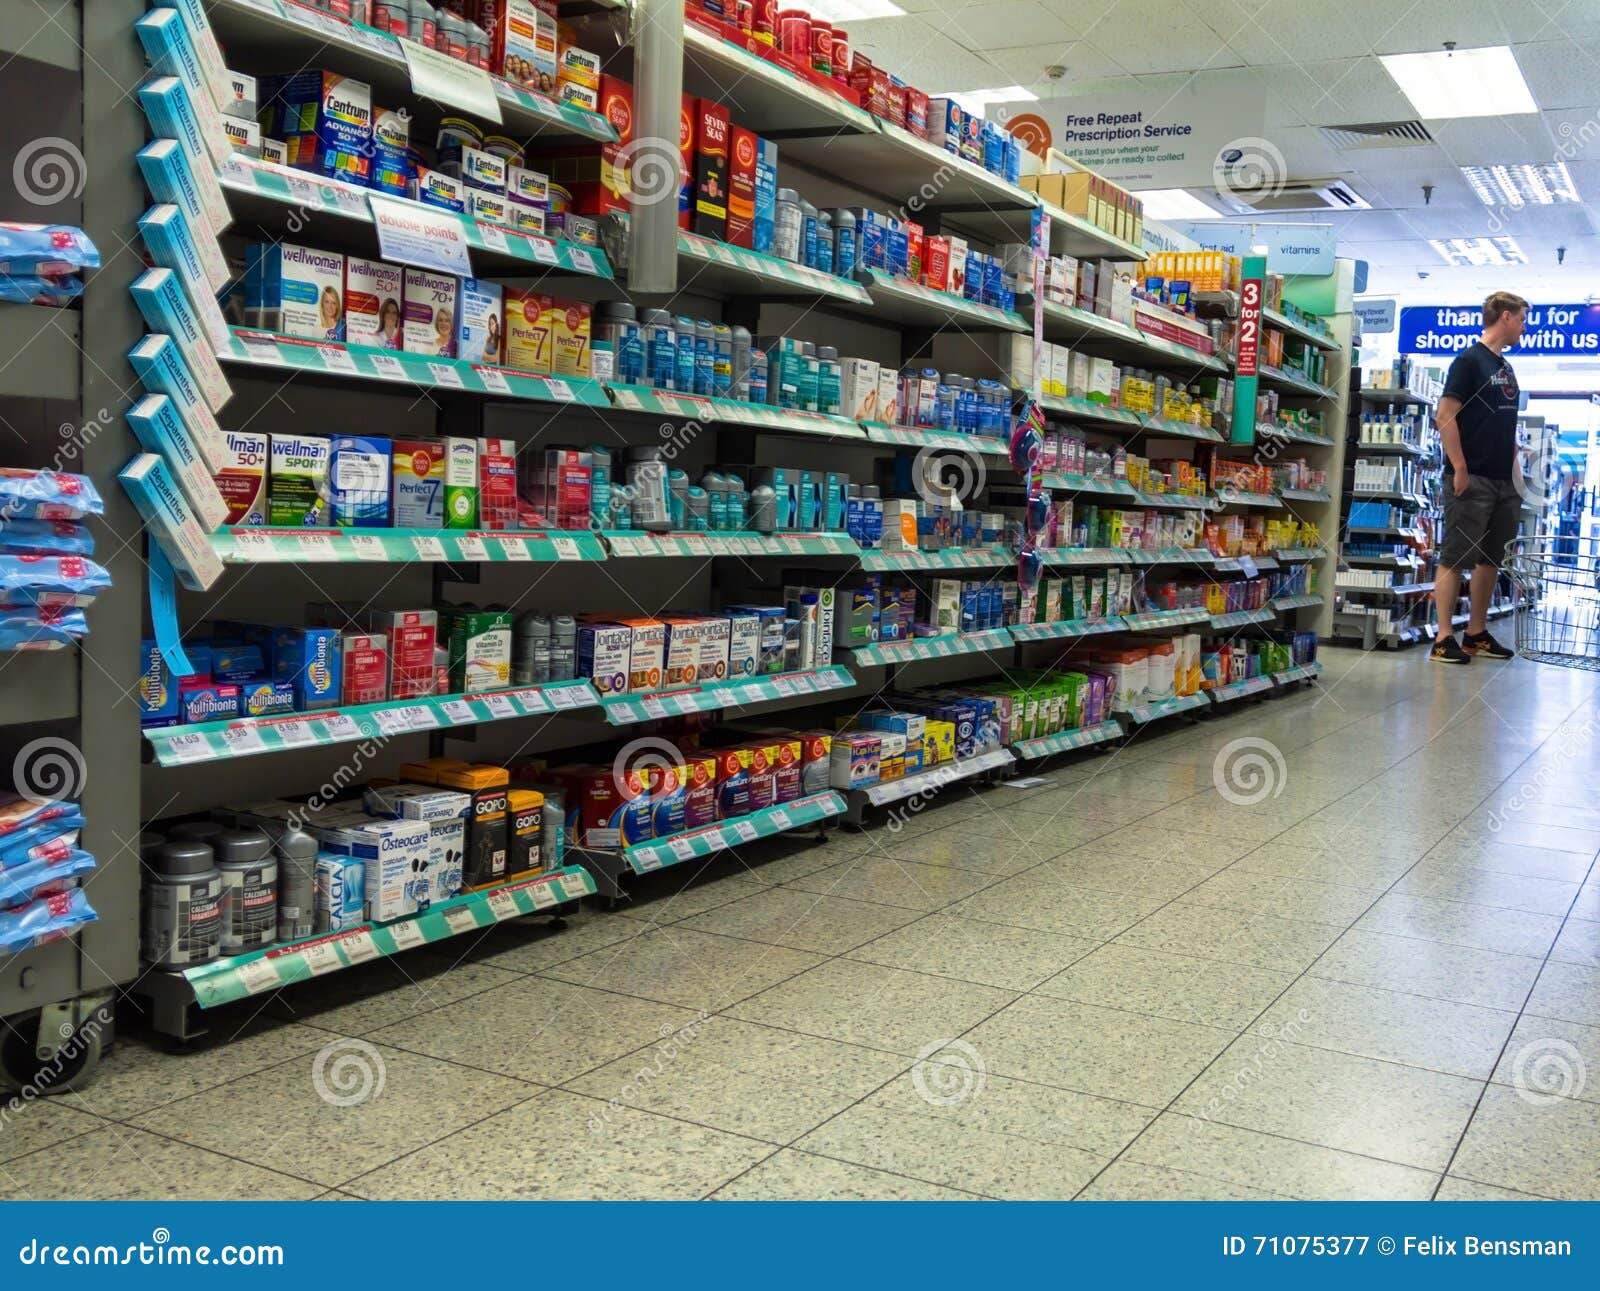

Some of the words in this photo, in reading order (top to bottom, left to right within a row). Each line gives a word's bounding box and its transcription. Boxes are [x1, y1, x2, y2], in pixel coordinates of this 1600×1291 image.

[170, 19, 201, 87] Bepanthen
[566, 50, 595, 69] Centrum
[563, 84, 594, 103] Centrum
[326, 96, 369, 120] Centrum
[173, 87, 201, 155] Bepanthen
[704, 114, 726, 132] SEVEN
[1066, 115, 1094, 127] Free
[1096, 111, 1142, 126] Repeat
[223, 121, 248, 139] trum
[376, 125, 407, 144] Centrum
[706, 127, 724, 142] SEAS
[1065, 127, 1141, 142] Prescription
[1143, 124, 1192, 138] Service
[1100, 147, 1116, 157] you
[1117, 145, 1139, 154] when
[1140, 144, 1160, 154] your
[1107, 157, 1120, 165] are
[1122, 154, 1145, 164] ready
[1146, 154, 1156, 162] to
[1157, 153, 1185, 162] collect
[475, 157, 503, 176] Centrum
[171, 150, 201, 216] Bepanthen
[429, 176, 456, 194] Centrum
[520, 175, 547, 191] Centrum
[476, 196, 504, 213] Centrum
[517, 210, 543, 225] Centrum
[379, 214, 421, 232] double
[423, 223, 458, 242] points
[172, 214, 201, 278] Bepanthen
[1220, 244, 1235, 253] aid
[1280, 245, 1320, 255] vitamins
[283, 248, 342, 270] wellwoman
[350, 262, 400, 282] wellwoman
[376, 280, 399, 293] 50+
[406, 273, 455, 293] wellwoman
[431, 291, 453, 303] 70+
[1244, 283, 1258, 304] 3
[164, 279, 197, 341] Bepanthen
[1241, 307, 1259, 319] for
[1437, 309, 1484, 326] than
[1547, 310, 1579, 326] for
[1241, 322, 1256, 343] 2
[1519, 331, 1565, 348] with
[1572, 333, 1599, 348] us
[512, 327, 541, 340] Perfect
[532, 327, 549, 360] 7
[557, 336, 581, 348] Perfect
[574, 335, 587, 366] 7
[163, 344, 197, 404] Bepanthen
[160, 405, 194, 464] Bepanthen
[272, 440, 326, 458] wellman
[237, 453, 265, 465] 50+
[285, 457, 326, 469] SPORT
[150, 466, 187, 523] Bepanthen
[399, 483, 432, 495] Perfect
[422, 479, 441, 514] 7
[633, 627, 665, 644] Jointace
[671, 625, 700, 642] Jointace
[699, 620, 729, 638] Jointace
[822, 607, 834, 660] Jointace
[596, 630, 630, 648] Jointace
[314, 635, 327, 695] Multibionta
[147, 647, 161, 712] Multibionta
[186, 698, 237, 714] Multibionta
[247, 692, 292, 707] Multibionta
[475, 798, 507, 816] GOPO
[430, 822, 463, 838] teocare
[516, 814, 541, 829] GOPO
[381, 832, 429, 851] Osteocare
[330, 867, 343, 931] CALCIA
